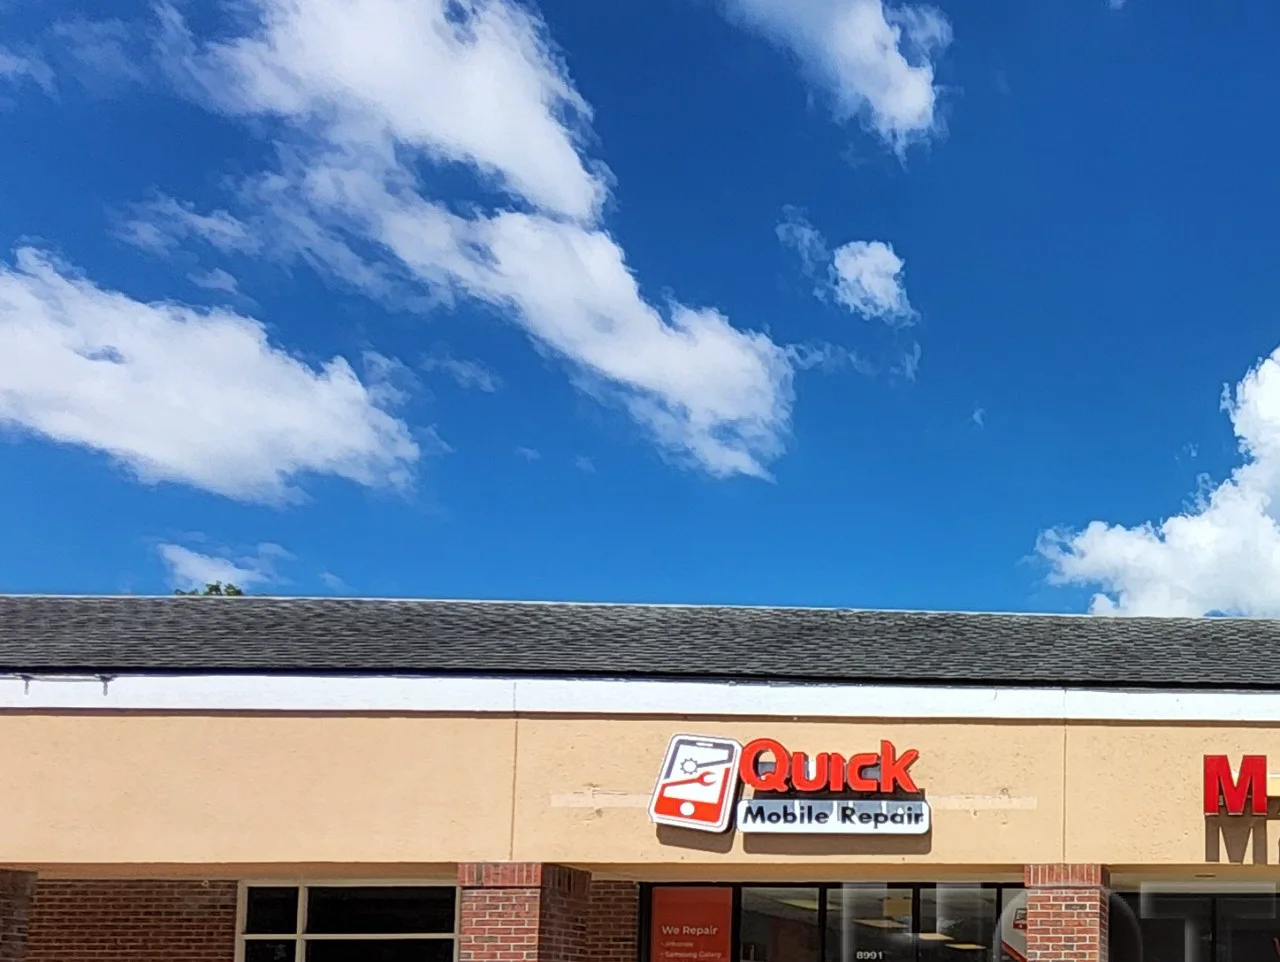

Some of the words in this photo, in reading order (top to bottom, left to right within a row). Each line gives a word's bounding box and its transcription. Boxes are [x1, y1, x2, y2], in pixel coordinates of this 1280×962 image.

[739, 738, 921, 793] Quick
[743, 806, 829, 825] Mobile
[841, 806, 924, 829] Repair
[662, 926, 680, 934] We
[682, 925, 718, 936] Repair
[856, 951, 883, 960] 8991
